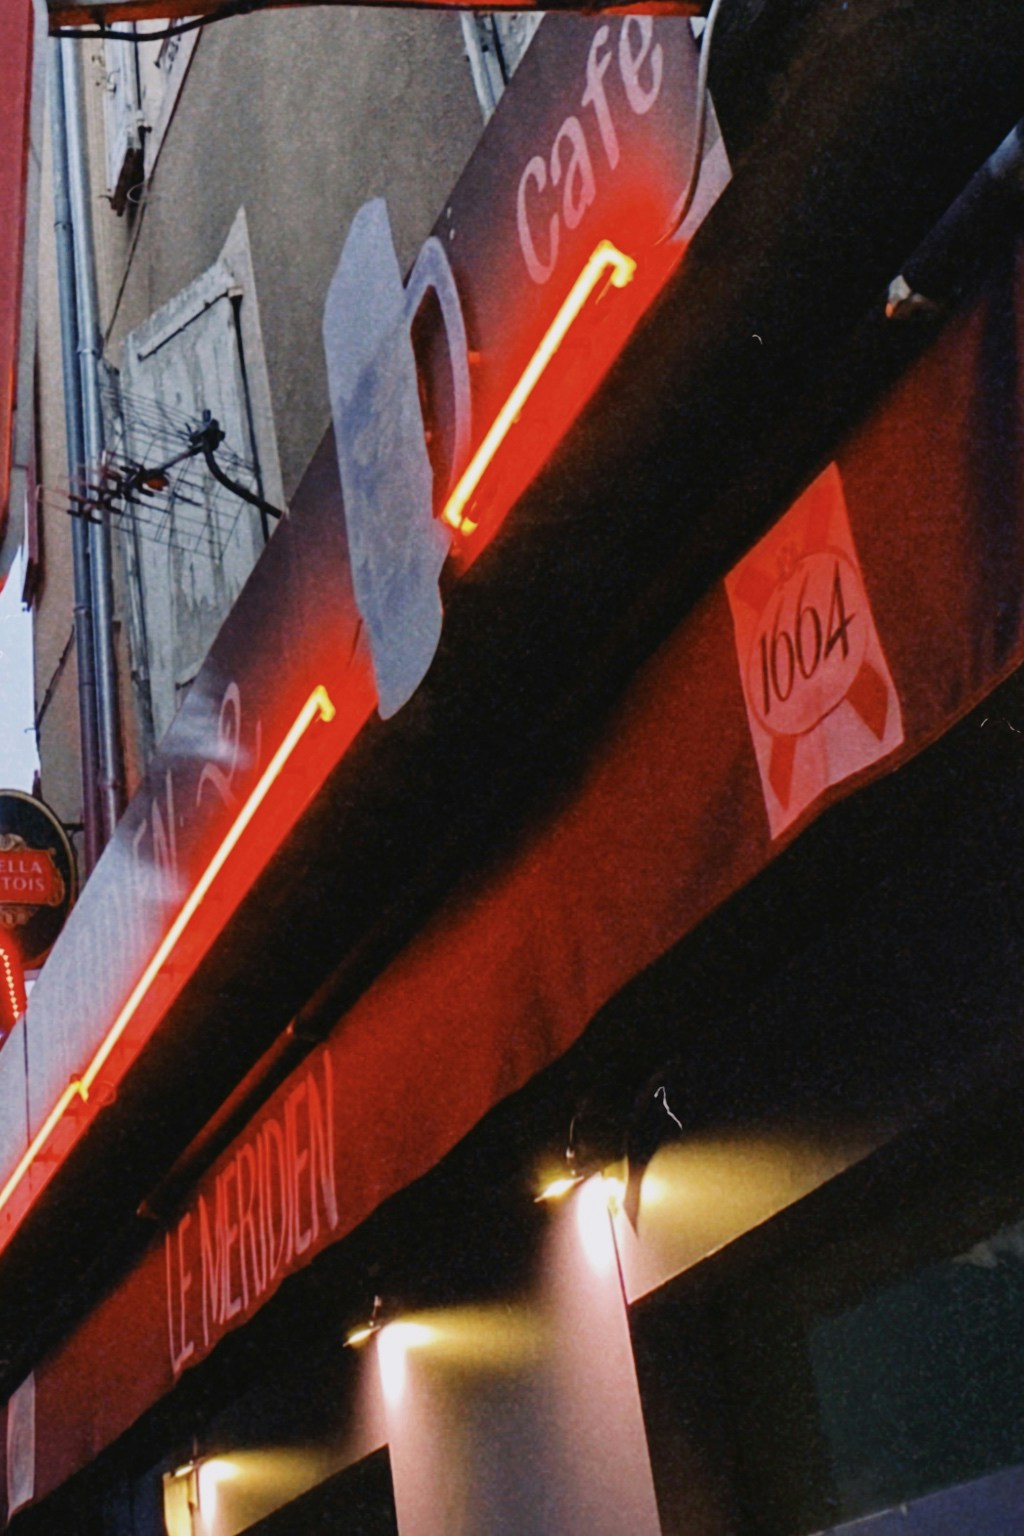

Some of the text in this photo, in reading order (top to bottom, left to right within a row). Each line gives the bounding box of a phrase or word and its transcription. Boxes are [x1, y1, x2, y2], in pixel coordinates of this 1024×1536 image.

[759, 559, 856, 717] 1664
[165, 1048, 339, 1375] LE MERIDIEN
